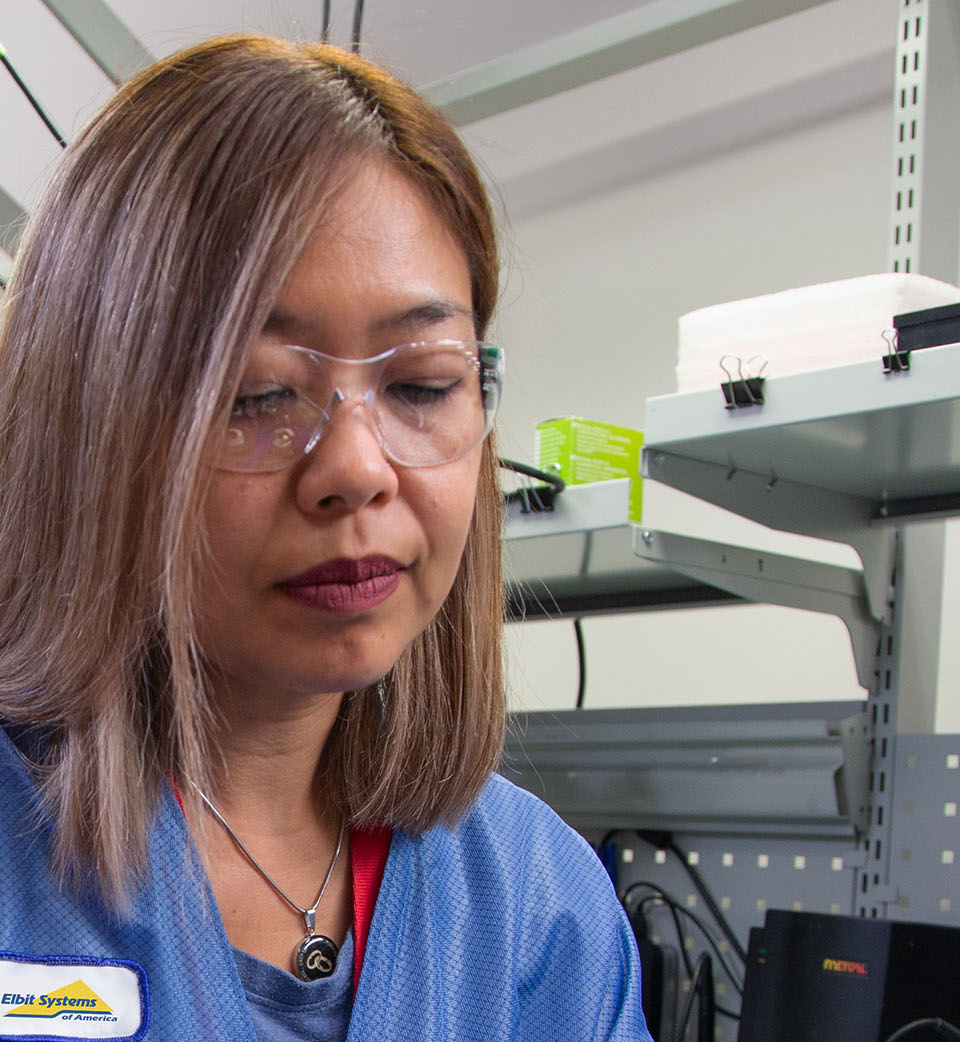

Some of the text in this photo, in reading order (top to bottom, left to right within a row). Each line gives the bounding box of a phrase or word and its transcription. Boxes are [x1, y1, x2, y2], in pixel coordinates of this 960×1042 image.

[1, 993, 97, 1008] Elbit Systems
[61, 1013, 118, 1022] of America
